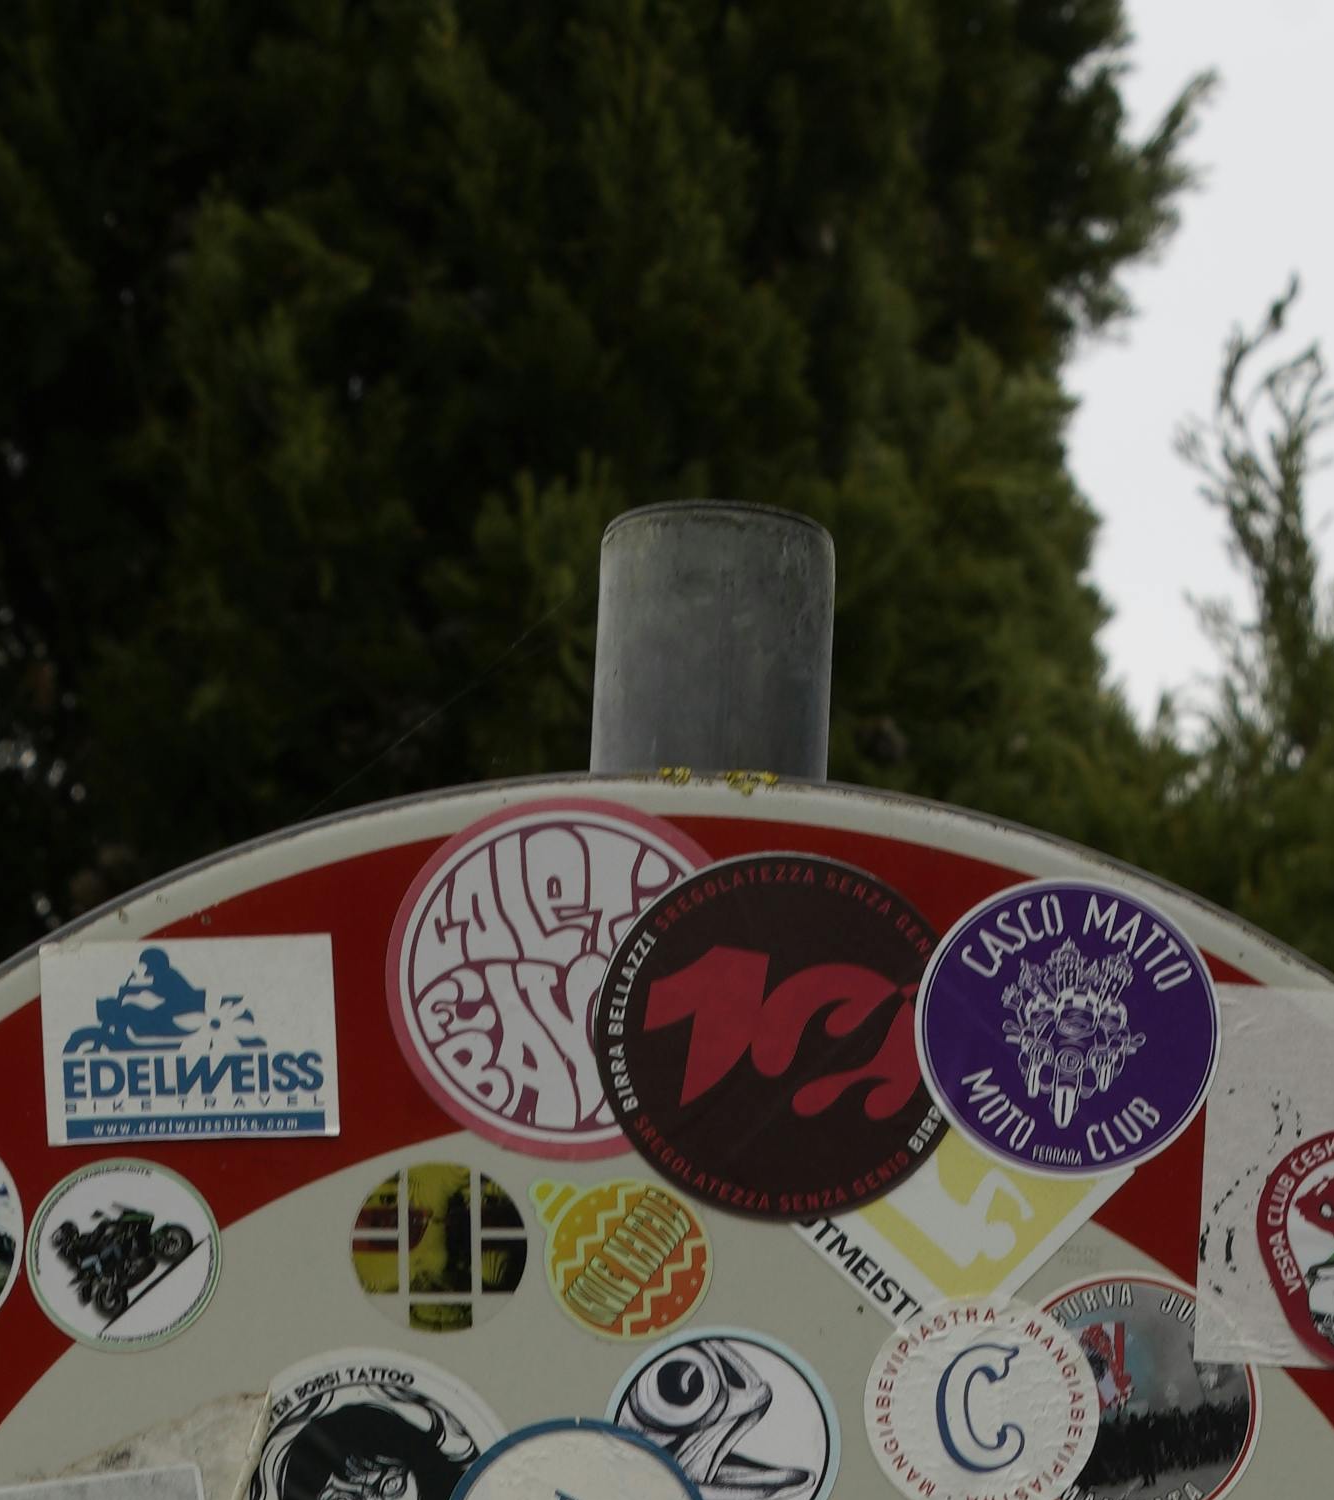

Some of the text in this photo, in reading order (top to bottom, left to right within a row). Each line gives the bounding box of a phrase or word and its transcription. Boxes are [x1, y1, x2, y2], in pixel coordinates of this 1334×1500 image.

[653, 864, 893, 931] SREGOLATEZZA SENZA
[961, 894, 1193, 992] CASCO MATTO
[606, 934, 659, 1112] BIRRA BELLAZZI
[63, 1050, 325, 1100] EDELWEISS
[64, 1094, 326, 1115] BIKE TRAVEL
[92, 1116, 299, 1136] www.edelweissbike.com
[961, 1066, 1162, 1164] MOTO CLUB
[634, 1114, 909, 1213] SREGOLATEZZA SENZA GENIO
[1031, 1144, 1083, 1166] FERRARA
[1268, 1175, 1294, 1228] CLUB
[1272, 1229, 1301, 1297] VESPA
[294, 1367, 416, 1403] BORSI TATTOO
